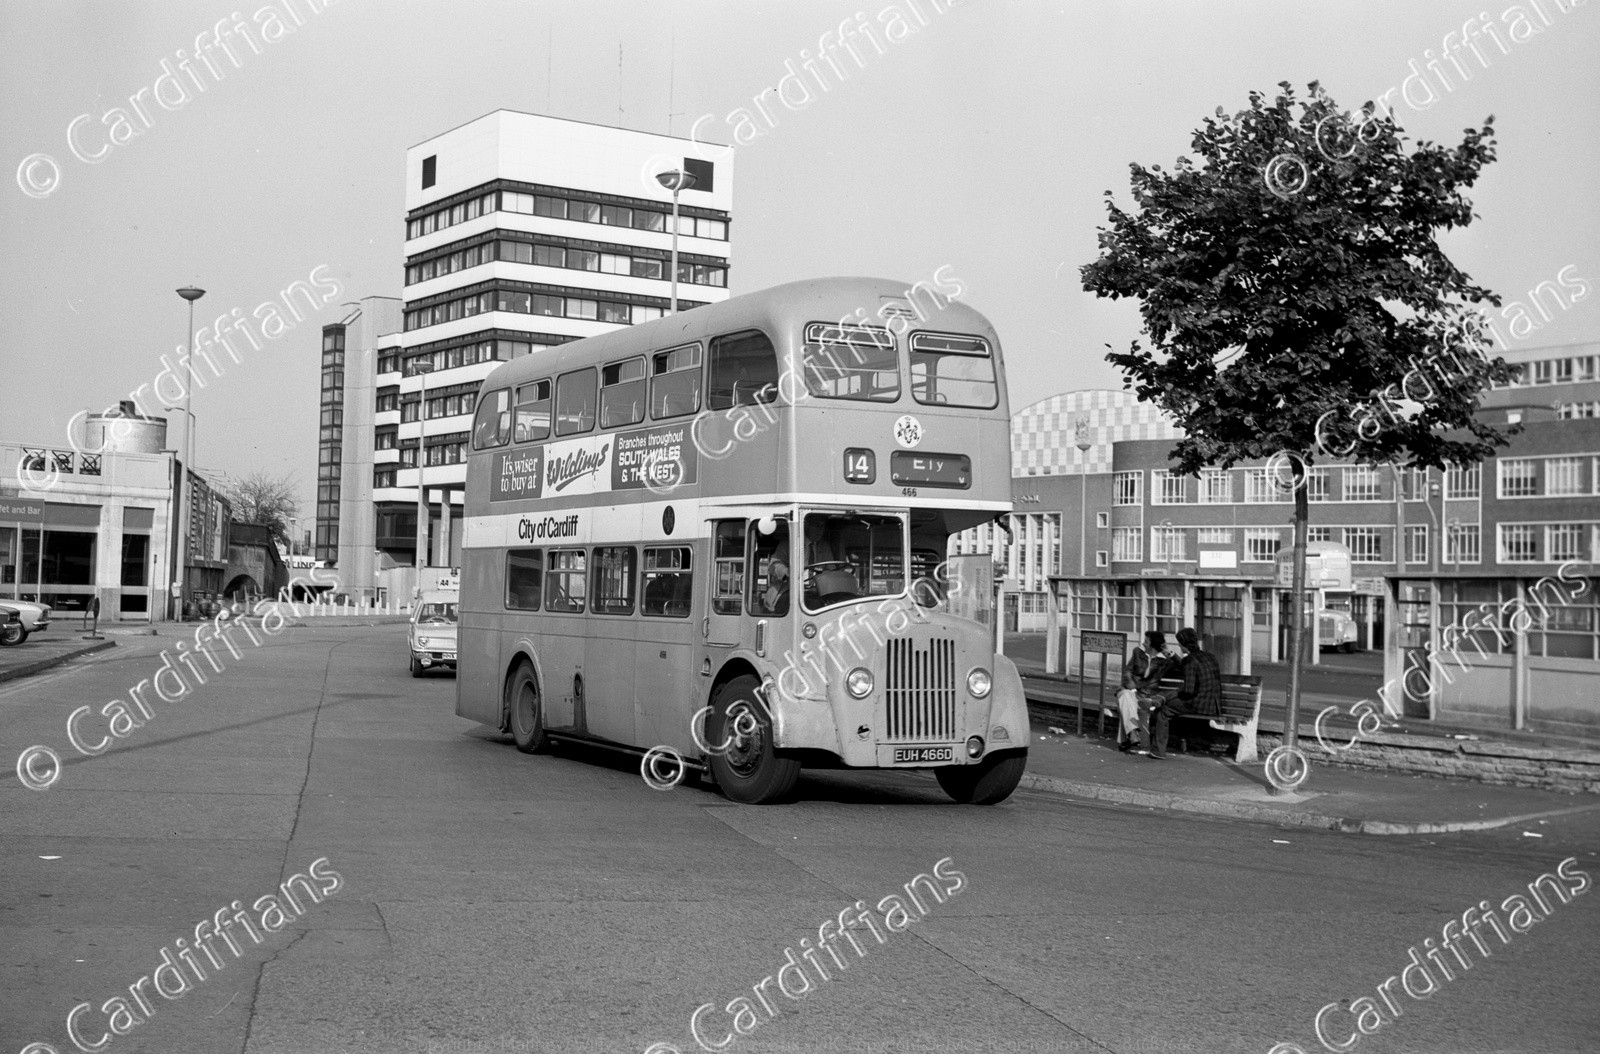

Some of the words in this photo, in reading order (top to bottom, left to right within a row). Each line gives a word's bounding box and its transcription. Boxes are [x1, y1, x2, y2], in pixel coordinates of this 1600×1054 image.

[619, 435, 647, 450] Branches
[648, 430, 684, 447] throughout
[514, 453, 538, 473] wiser
[619, 451, 648, 467] SOUTH
[649, 446, 681, 462] WALES
[848, 455, 869, 473] 14
[913, 458, 944, 472] Ely
[621, 471, 628, 482] &
[630, 468, 647, 481] THE
[501, 476, 509, 492] to
[511, 474, 526, 495] buy
[527, 475, 537, 490] at
[901, 488, 918, 497] 466
[28, 506, 41, 515] Bar
[518, 519, 536, 543] City
[537, 517, 548, 538] of
[547, 515, 579, 538] Cardiff
[895, 749, 919, 761] EUH
[921, 748, 952, 760] 466D
